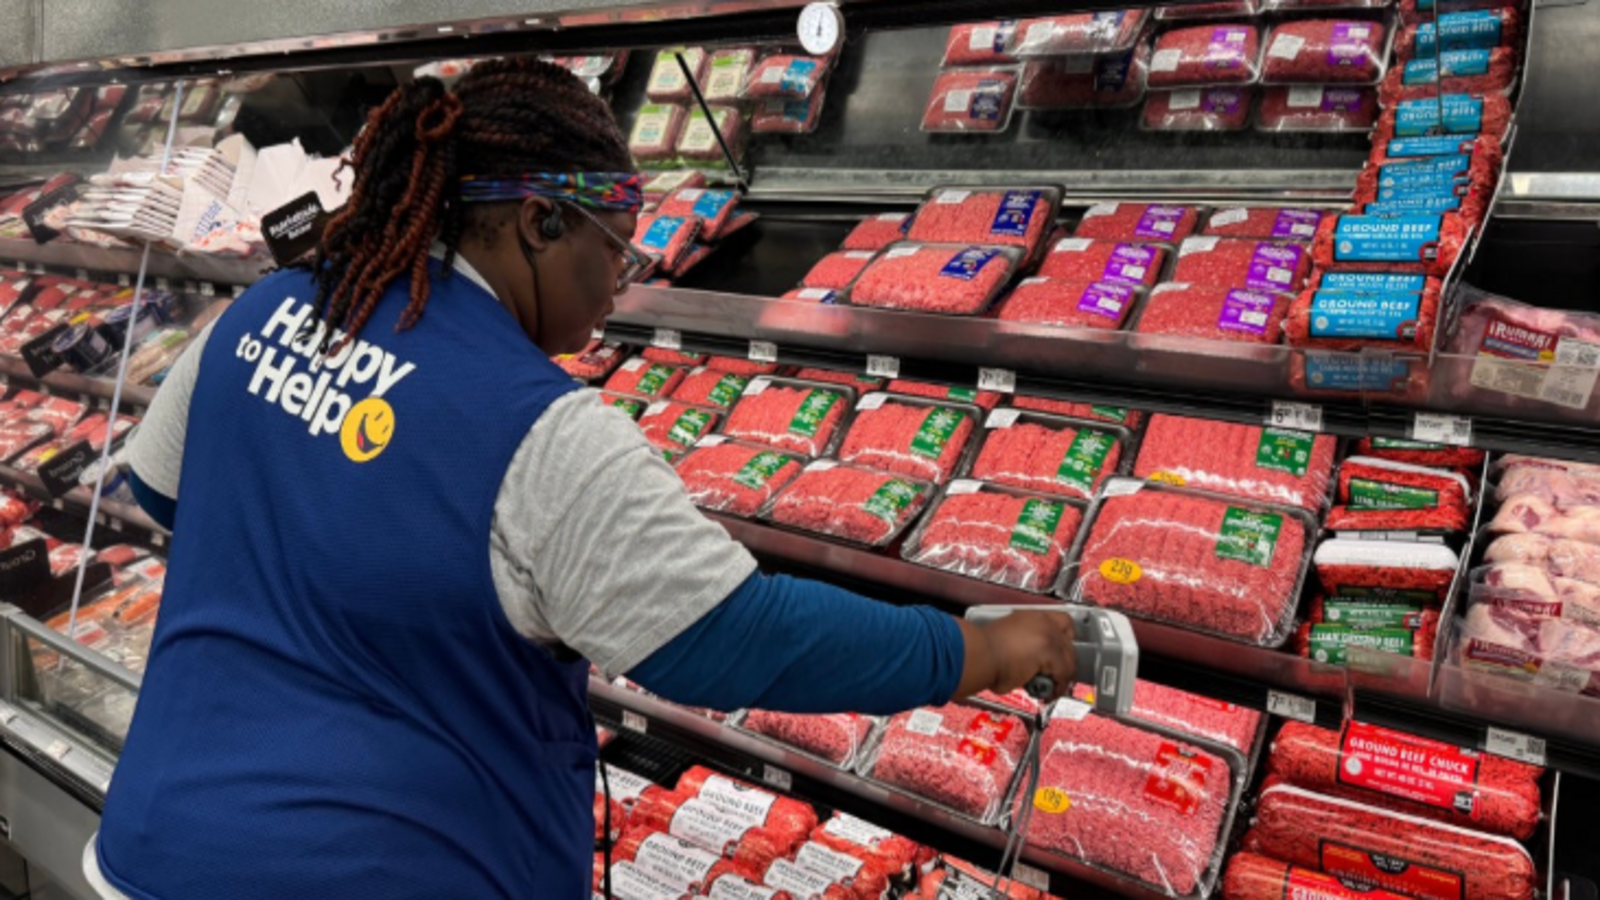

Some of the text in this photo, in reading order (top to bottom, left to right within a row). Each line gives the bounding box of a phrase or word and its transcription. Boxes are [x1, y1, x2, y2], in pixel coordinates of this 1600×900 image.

[1342, 224, 1432, 232] GROUND BEEF
[1328, 274, 1418, 283] GROUND BEEF
[1318, 299, 1411, 310] GROUND BEEF
[236, 332, 262, 362] to
[261, 296, 417, 398] Happy
[247, 346, 352, 436] Help
[1350, 737, 1469, 775] GROUND BEEF CHUCK
